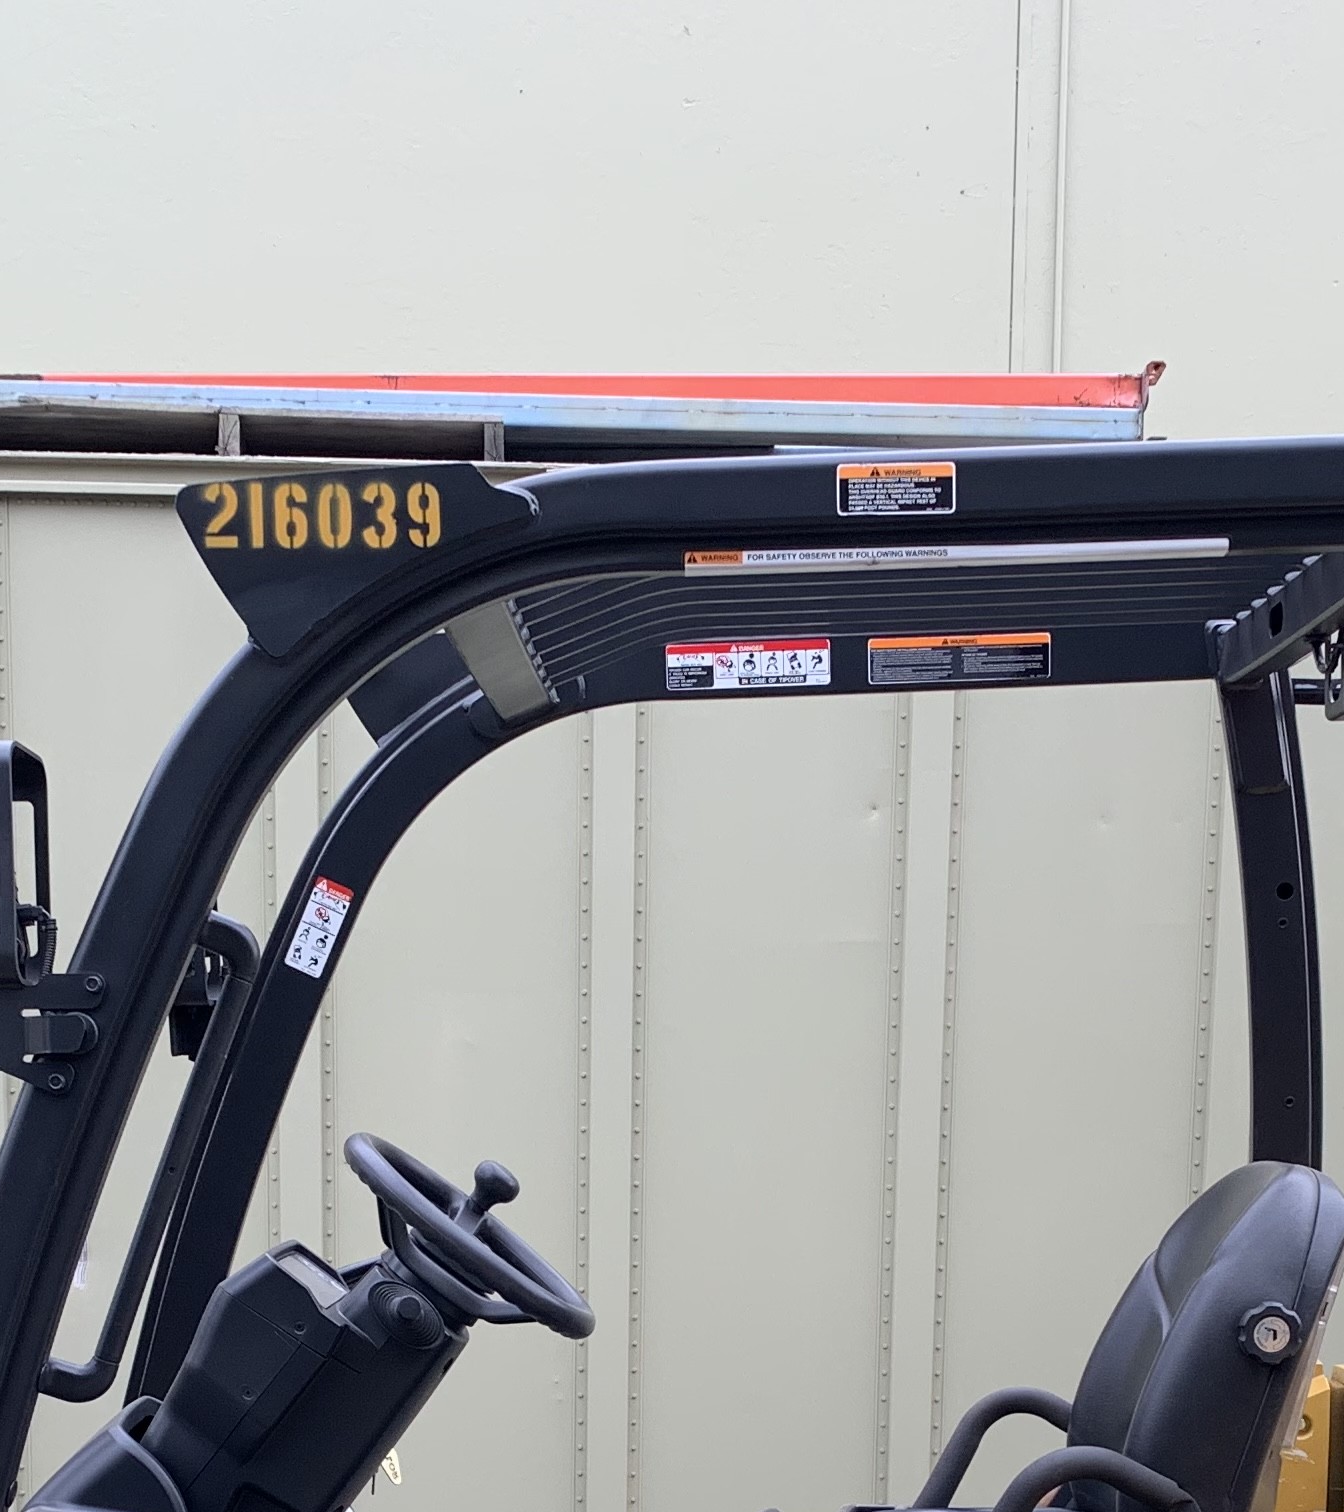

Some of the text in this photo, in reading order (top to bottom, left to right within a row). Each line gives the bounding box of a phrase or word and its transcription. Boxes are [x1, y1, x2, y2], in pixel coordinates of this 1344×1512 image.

[205, 482, 441, 549] 216039
[747, 553, 764, 561] FOR
[766, 552, 796, 561] SAFETY
[799, 551, 836, 560] OBSERVE
[839, 551, 854, 559] THE
[856, 550, 903, 559] FOLLOWING
[905, 549, 948, 557] WARNINGS
